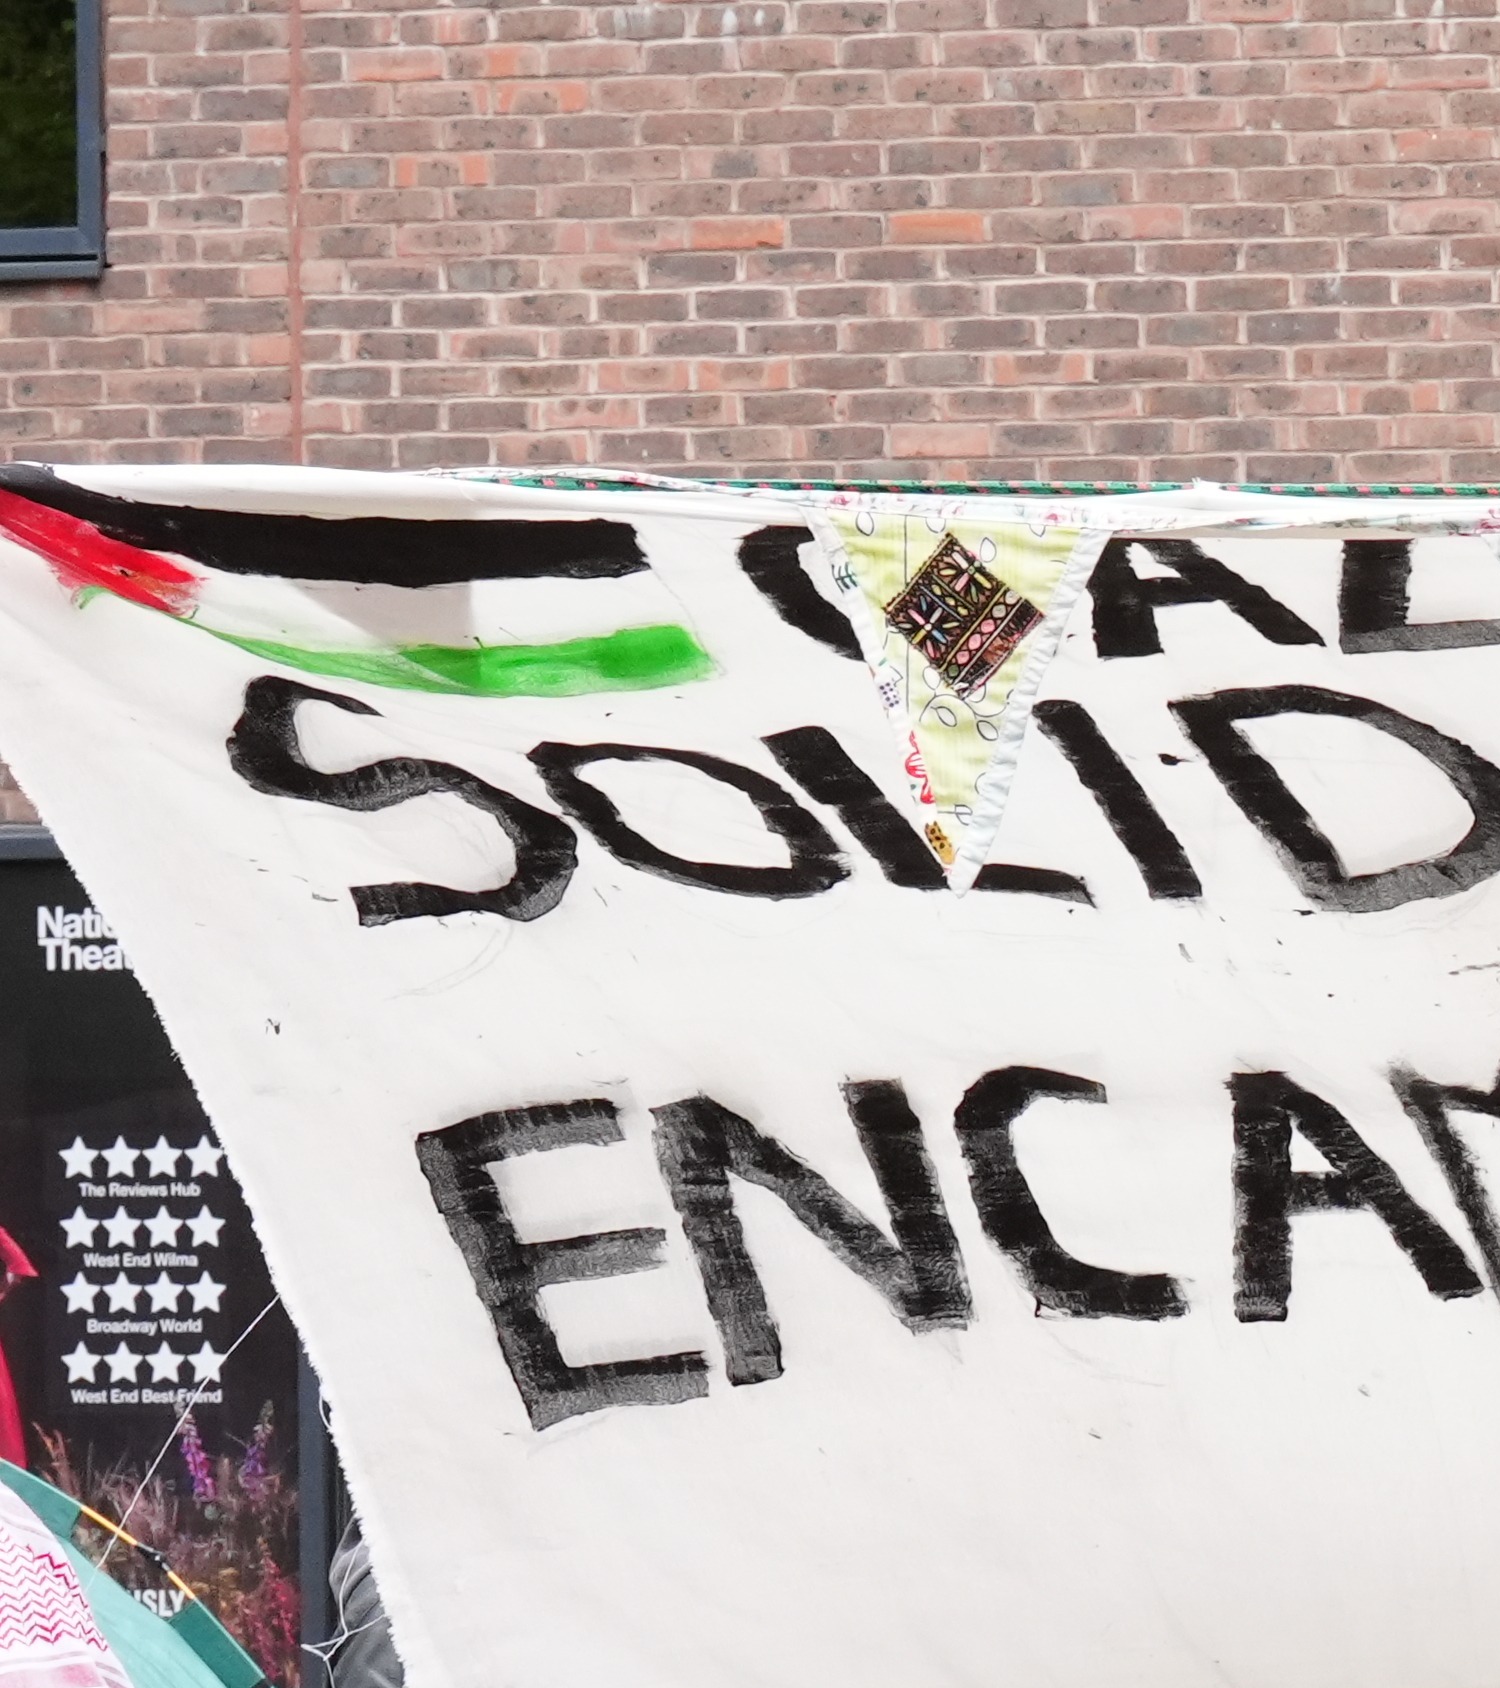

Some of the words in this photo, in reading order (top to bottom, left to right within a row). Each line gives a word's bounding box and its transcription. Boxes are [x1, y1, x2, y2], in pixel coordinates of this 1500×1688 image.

[79, 1182, 105, 1197] The
[109, 1182, 168, 1197] Reviews
[171, 1182, 201, 1197] Hub
[84, 1252, 119, 1268] West
[123, 1252, 151, 1268] End
[154, 1252, 198, 1268] Wilma
[87, 1319, 157, 1335] Broadway
[161, 1319, 202, 1333] World
[72, 1388, 106, 1403] West
[110, 1388, 139, 1403] End
[142, 1388, 175, 1403] Best
[178, 1388, 222, 1403] Friend
